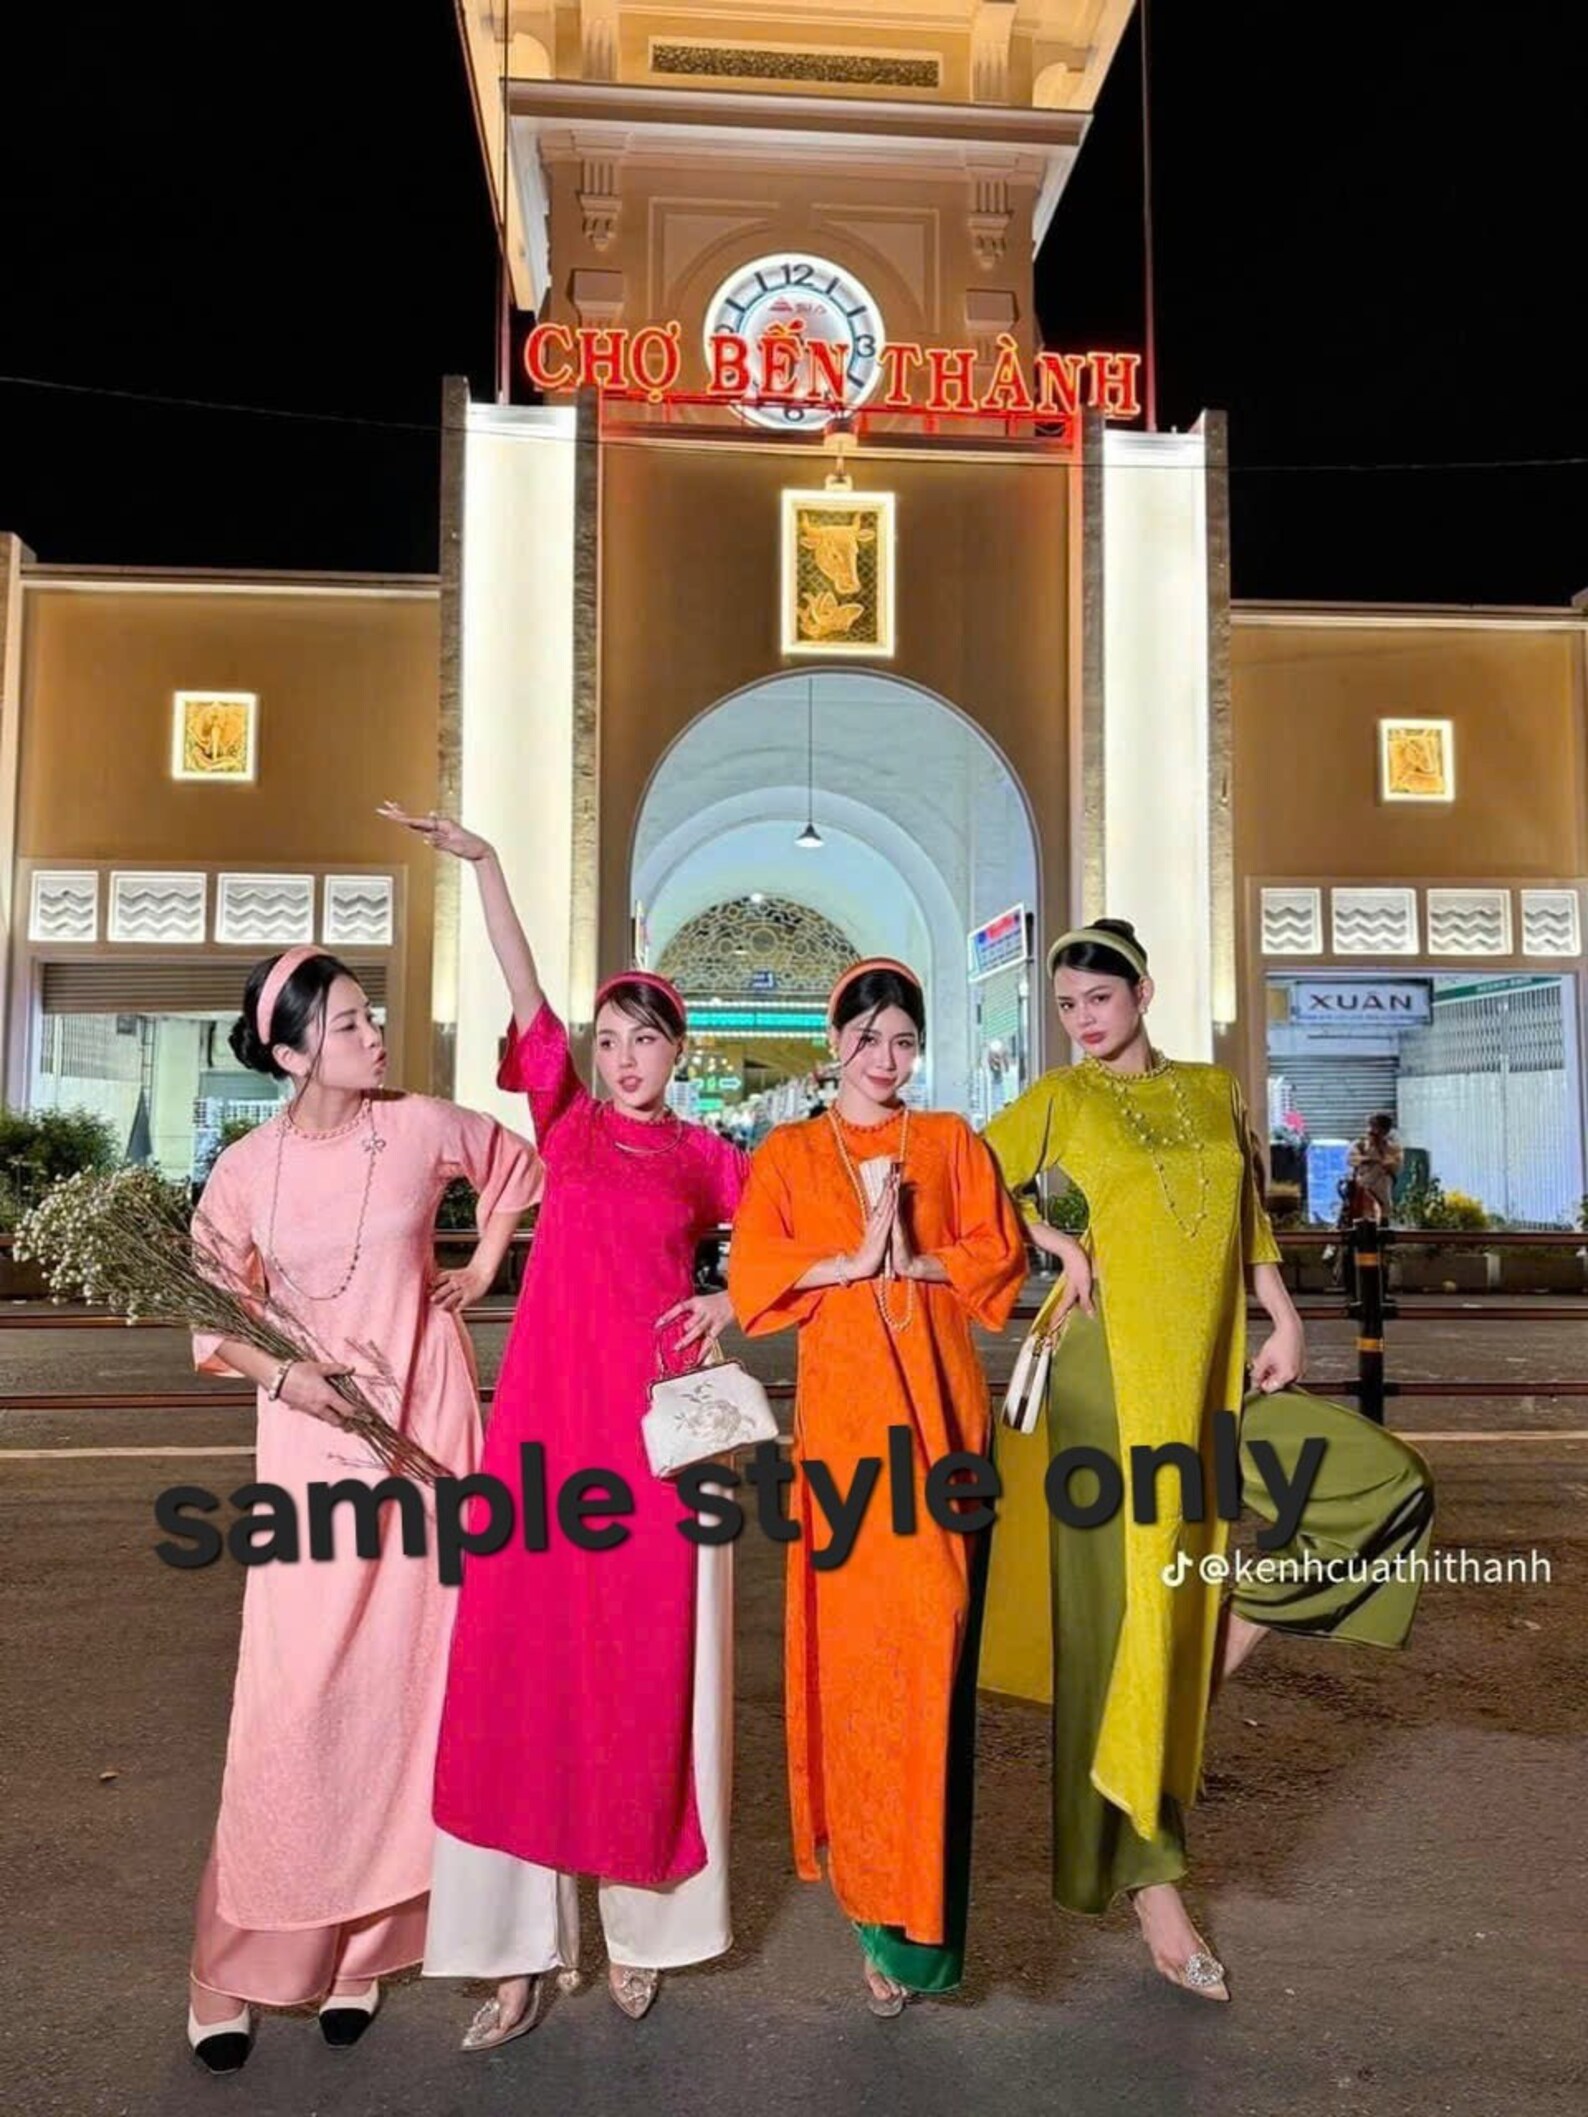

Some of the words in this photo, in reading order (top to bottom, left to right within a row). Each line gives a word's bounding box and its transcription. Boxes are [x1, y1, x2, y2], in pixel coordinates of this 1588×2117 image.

[781, 264, 814, 287] 12
[856, 334, 876, 358] 3
[525, 320, 681, 402] CHỢ
[707, 319, 850, 402] BẾN
[877, 333, 1140, 415] THÀNH
